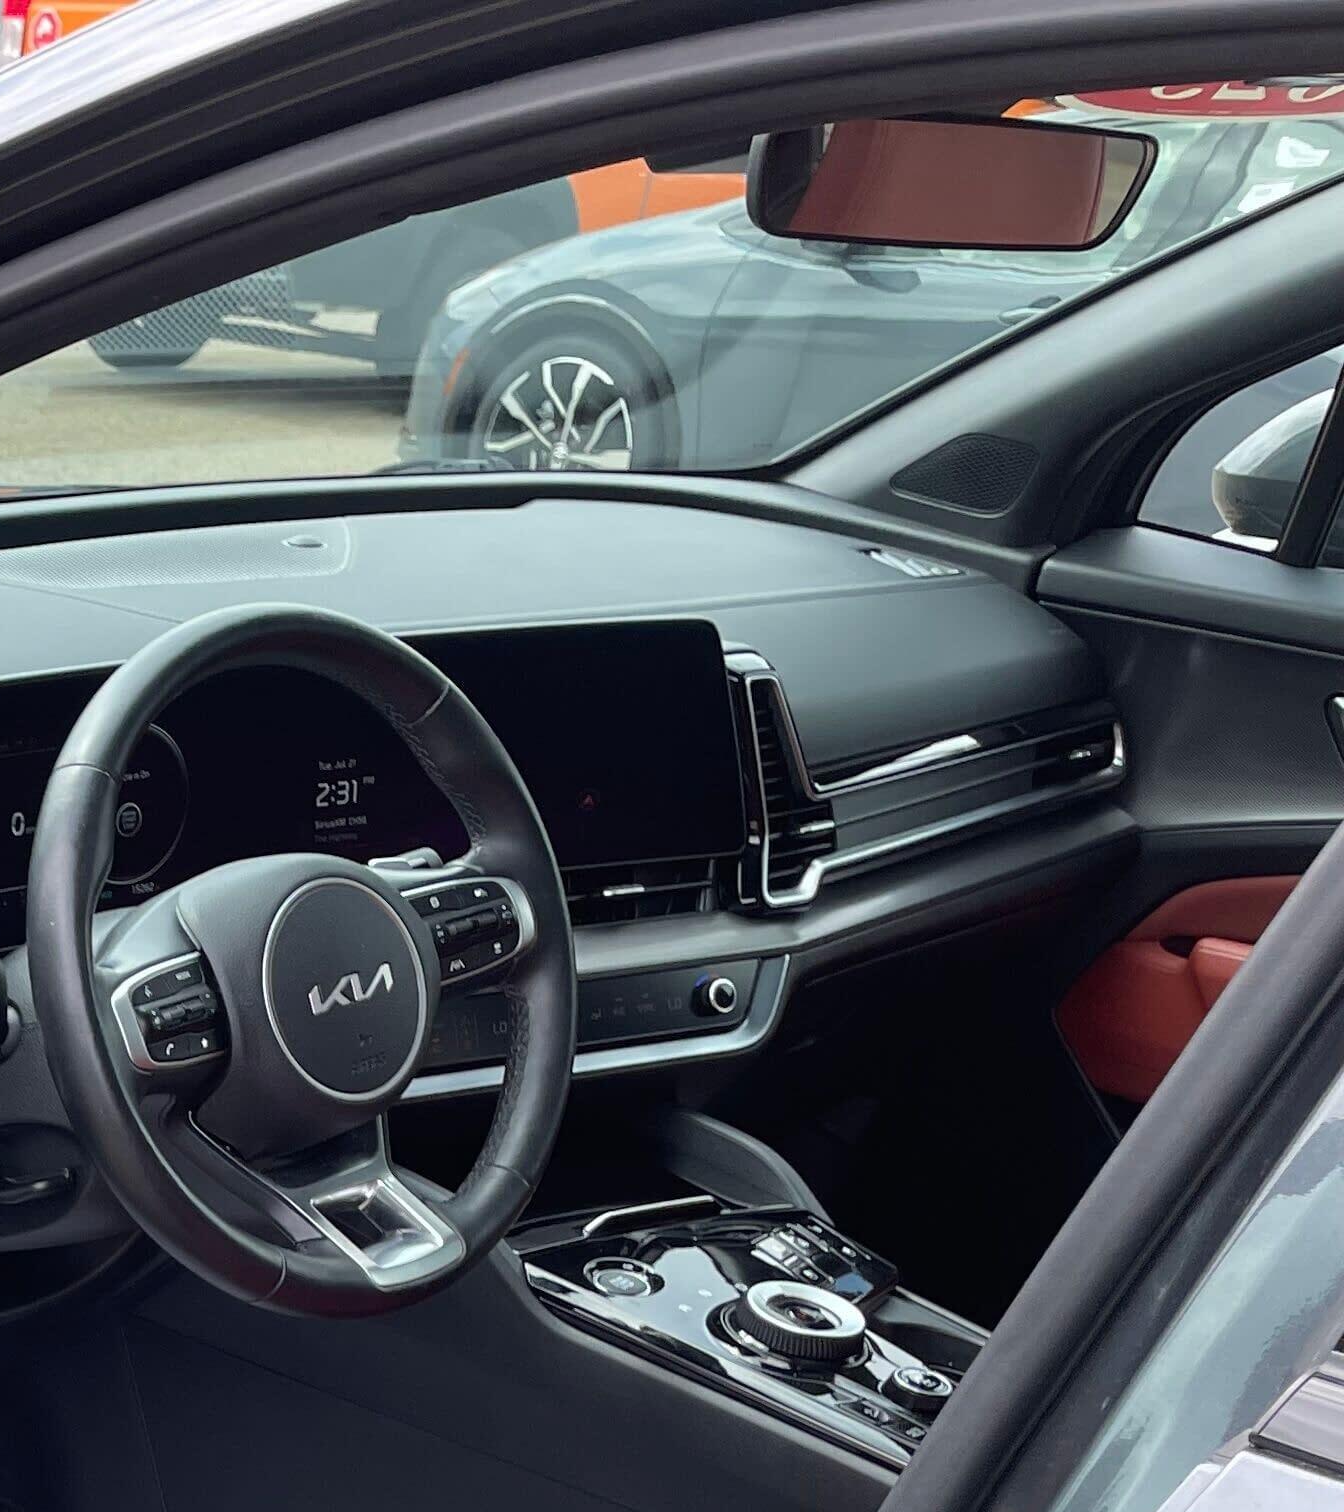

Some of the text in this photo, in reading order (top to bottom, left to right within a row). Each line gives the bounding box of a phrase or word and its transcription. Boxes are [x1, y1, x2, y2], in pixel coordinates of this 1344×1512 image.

[315, 779, 358, 807] 2:31
[11, 811, 25, 837] 0
[307, 961, 395, 1017] KIA
